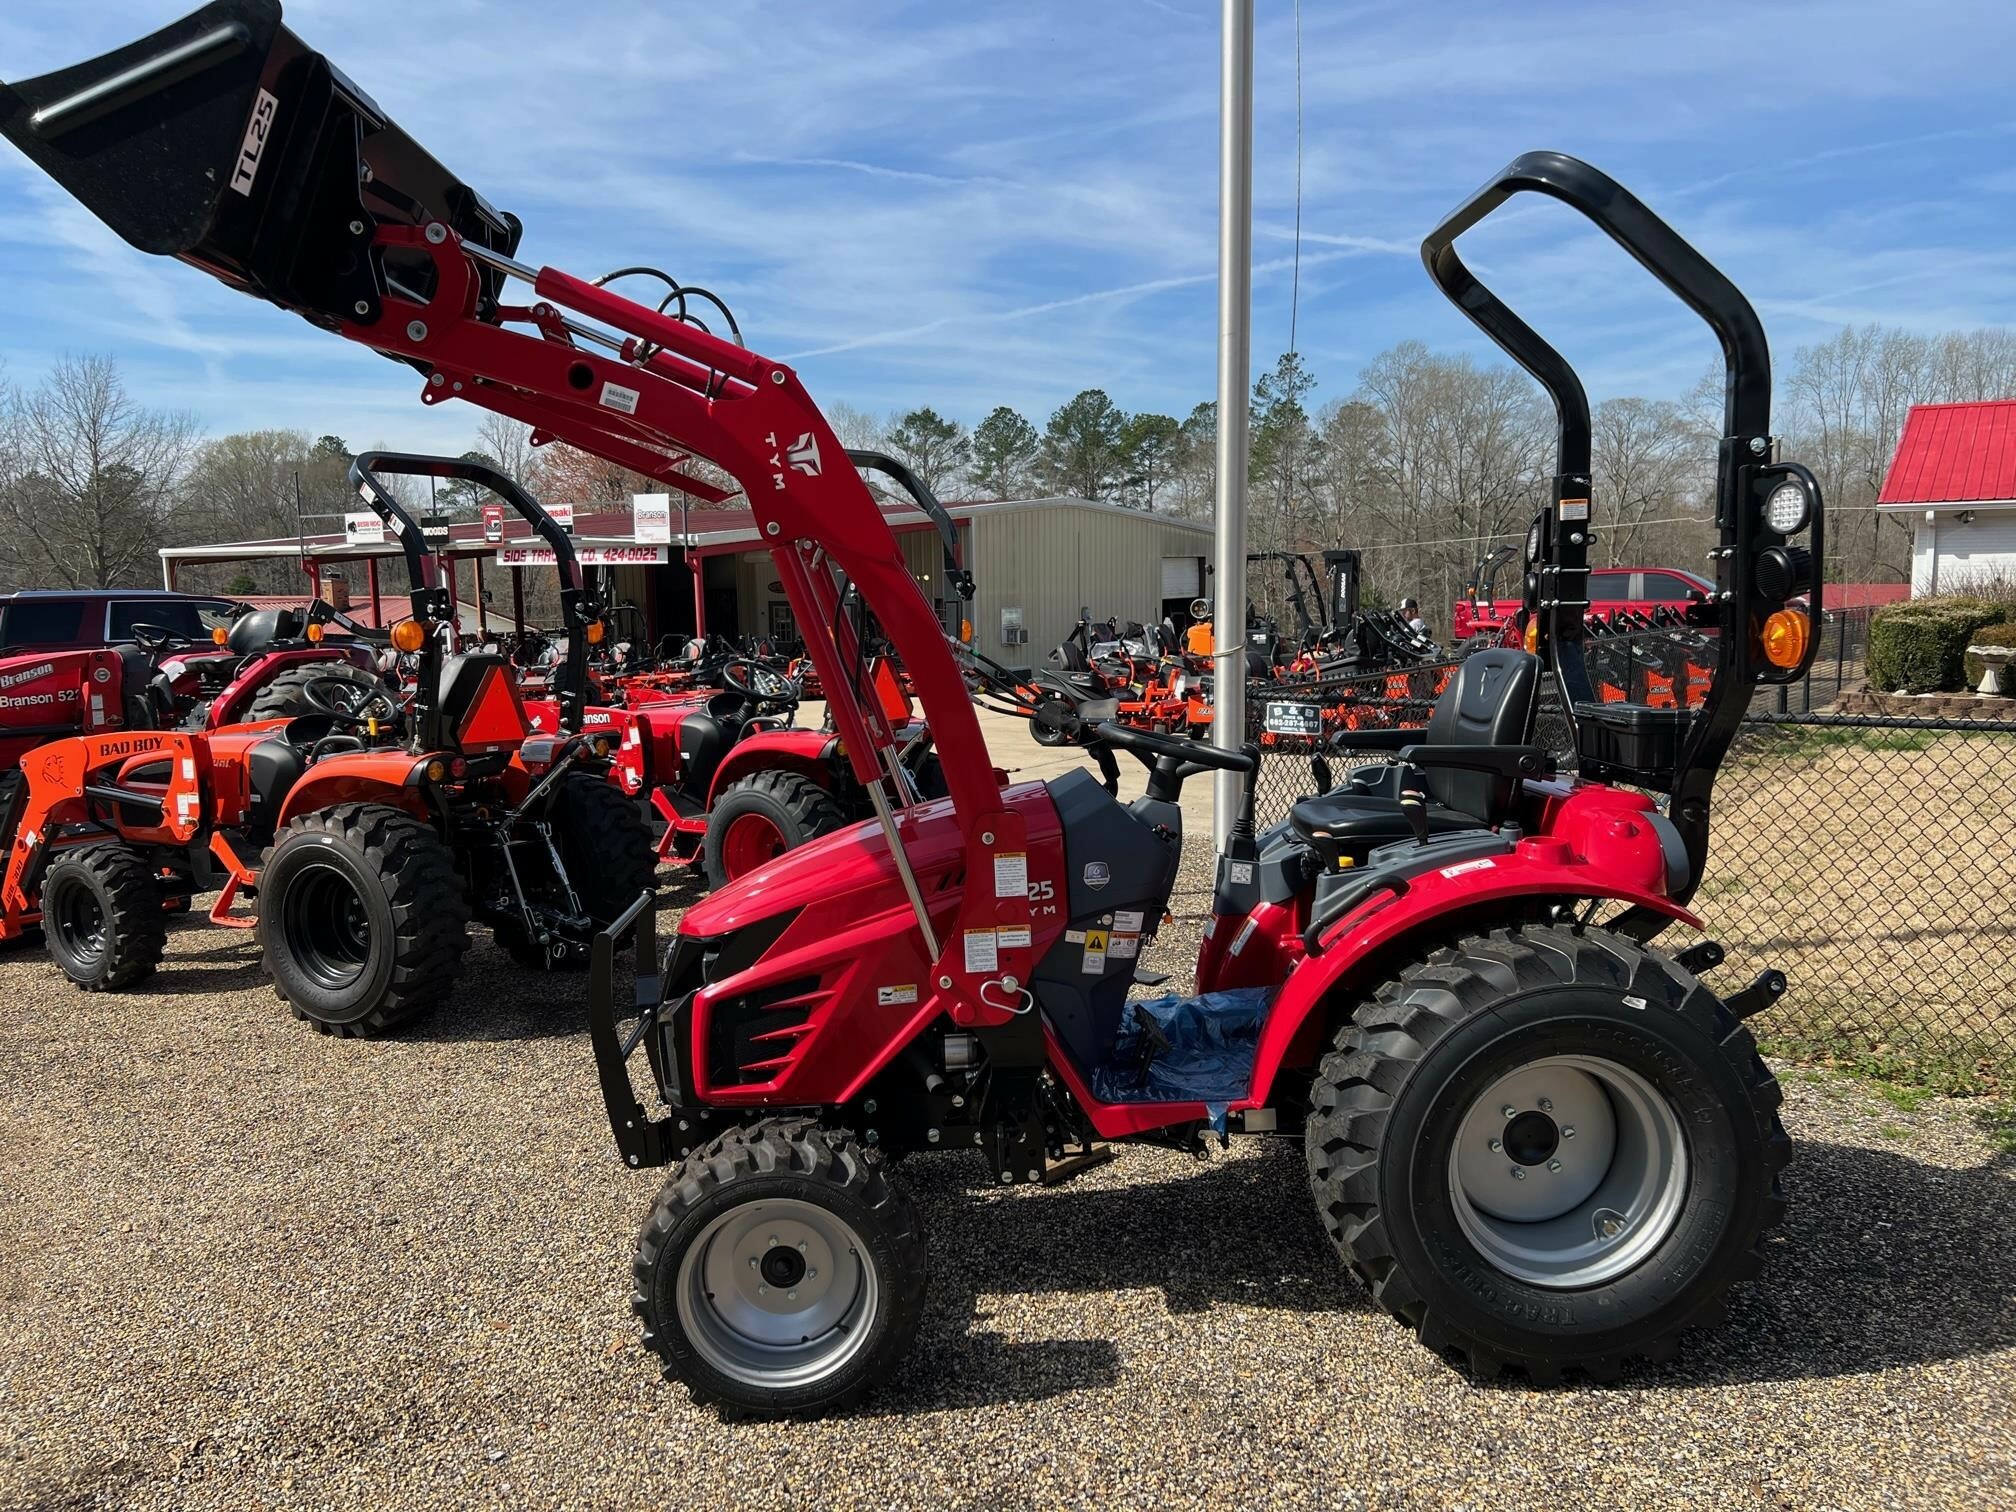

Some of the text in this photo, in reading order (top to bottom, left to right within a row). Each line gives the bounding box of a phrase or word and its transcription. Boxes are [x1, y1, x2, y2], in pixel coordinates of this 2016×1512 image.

[235, 97, 273, 184] TL25
[764, 431, 786, 490] TYM
[547, 507, 571, 516] asaki
[422, 526, 449, 537] WOODS
[0, 663, 54, 688] Branson
[0, 694, 54, 708] Branson
[583, 713, 611, 724] anson
[1273, 706, 1314, 718] B & B
[100, 735, 164, 757] BAD BOY
[1029, 905, 1056, 917] YM
